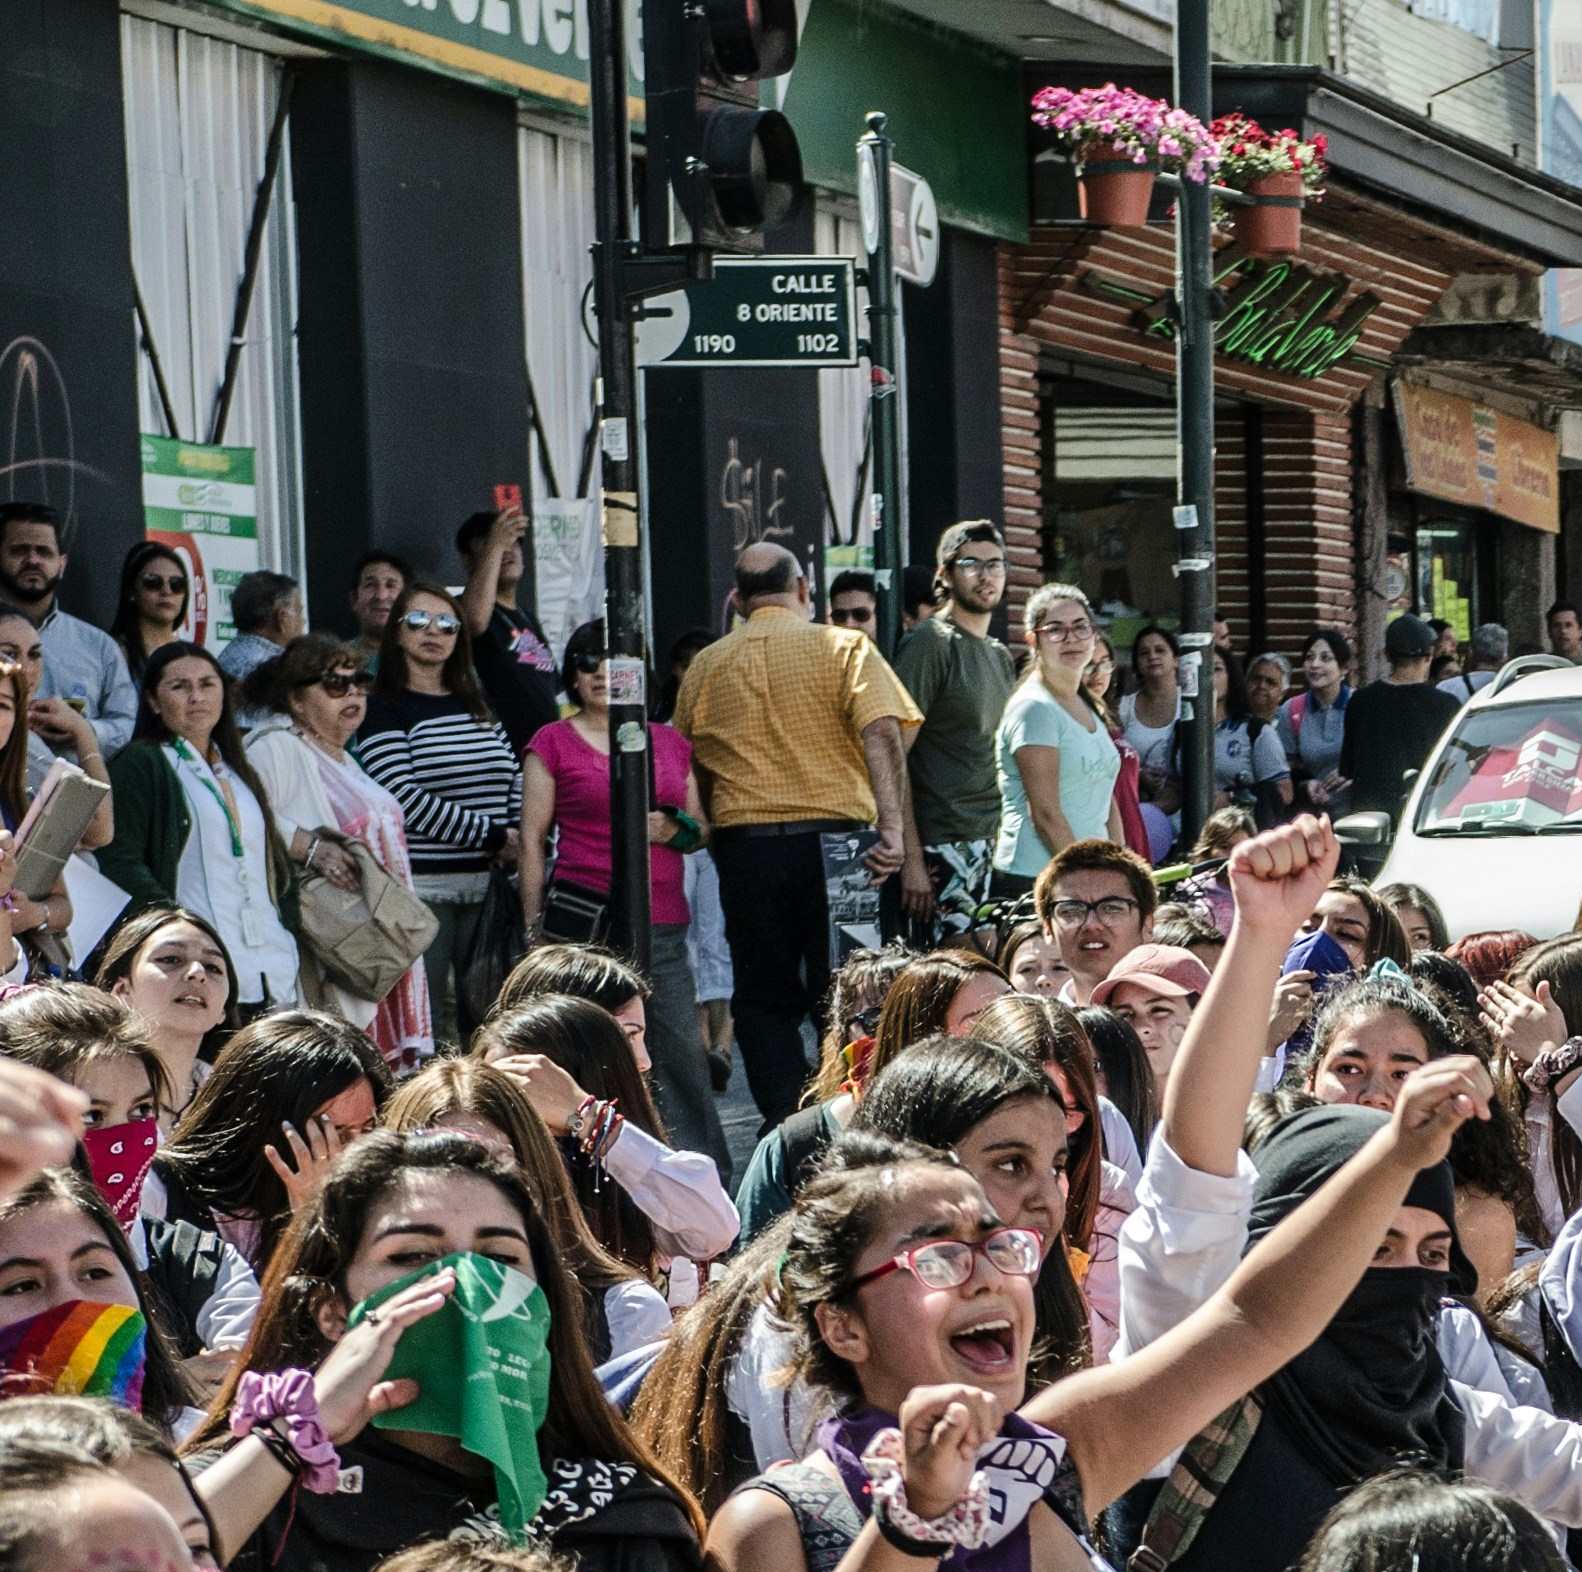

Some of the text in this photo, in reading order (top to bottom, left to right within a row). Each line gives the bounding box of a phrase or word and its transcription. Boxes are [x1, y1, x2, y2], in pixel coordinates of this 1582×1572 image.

[772, 274, 836, 294] CALLE
[737, 304, 838, 323] 8 ORIENTE
[694, 335, 839, 354] 1190 1102
